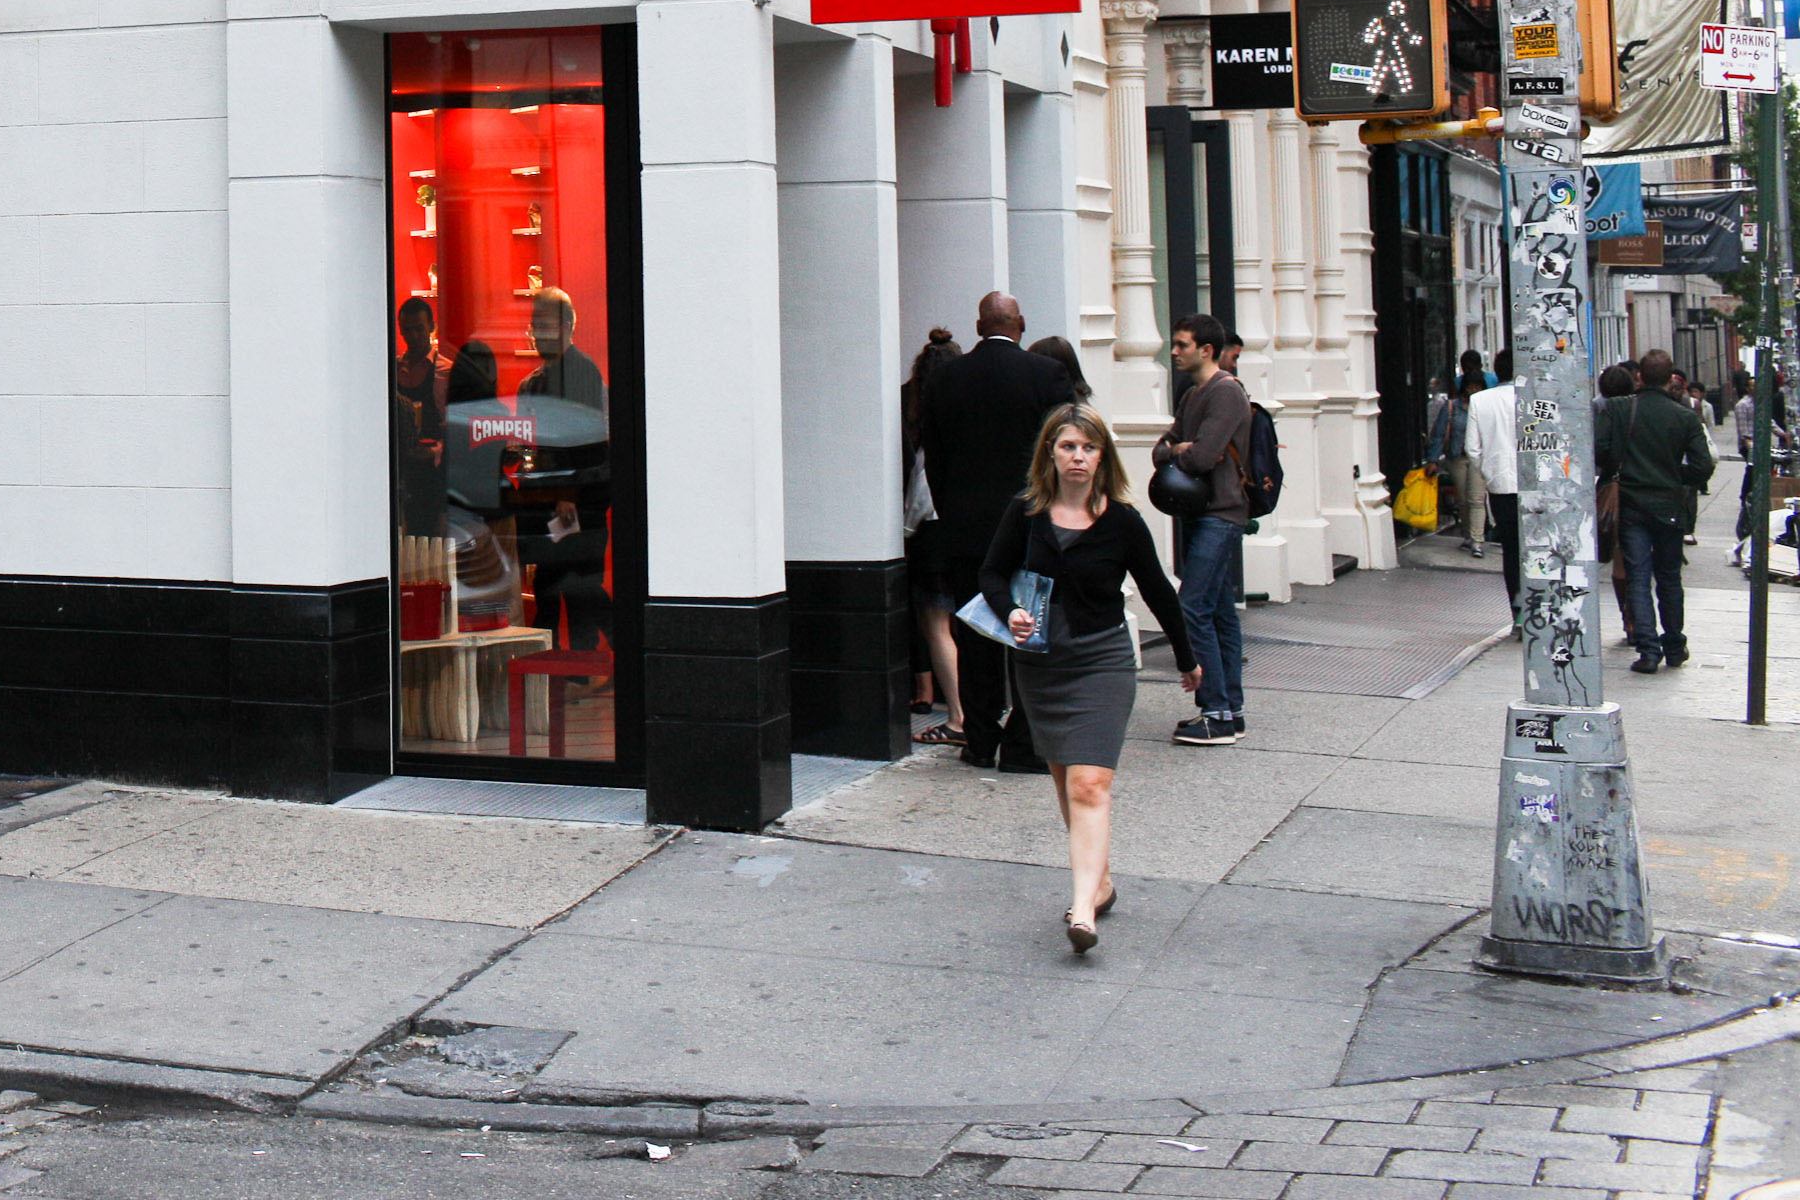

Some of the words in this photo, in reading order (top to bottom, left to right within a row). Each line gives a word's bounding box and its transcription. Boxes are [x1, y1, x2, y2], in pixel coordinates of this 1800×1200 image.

[1703, 29, 1723, 50] NO
[1730, 33, 1771, 48] PARKING
[1216, 47, 1279, 64] KAREN
[472, 419, 533, 443] CAMPER
